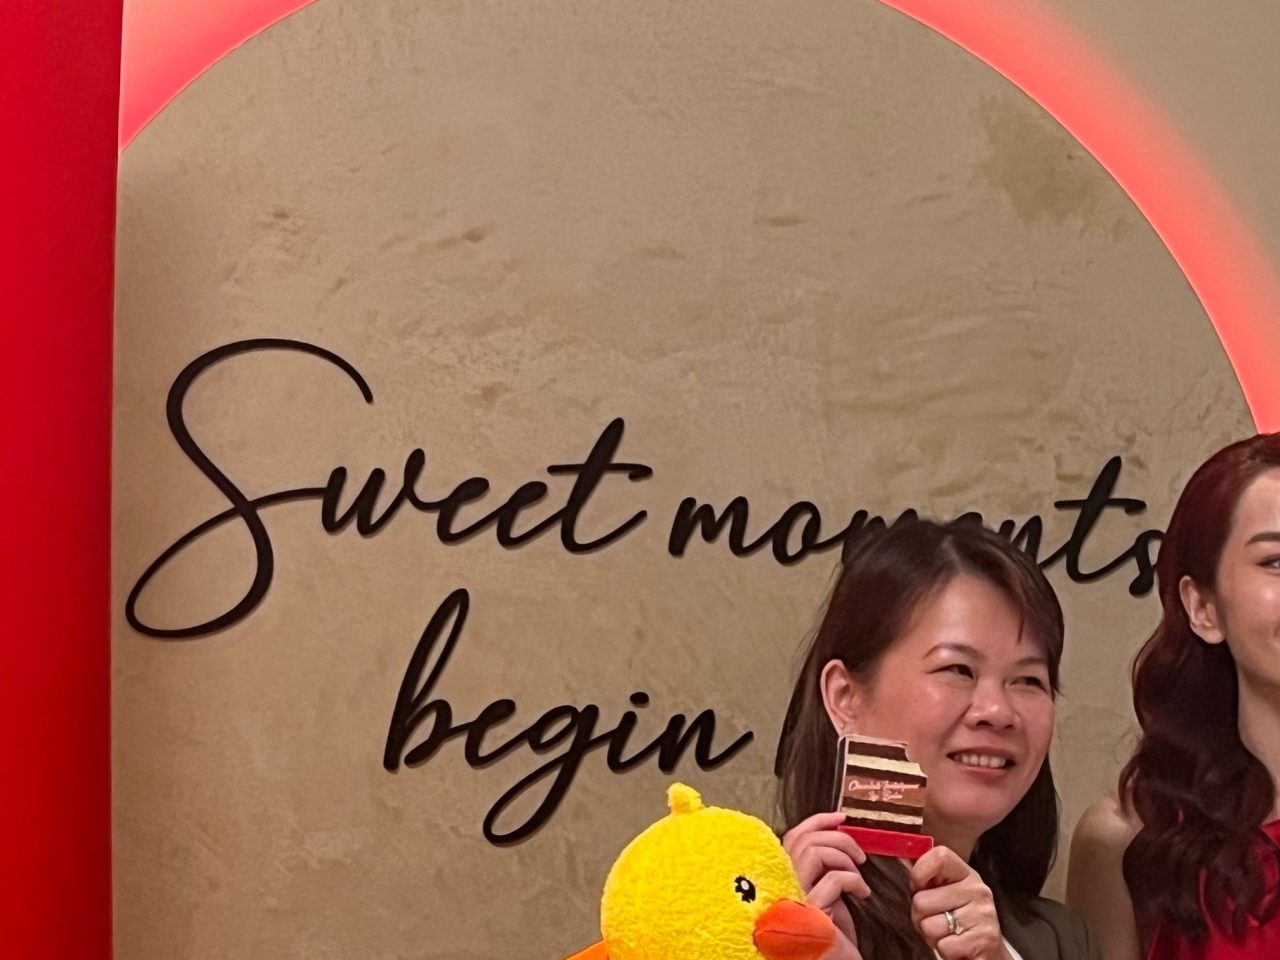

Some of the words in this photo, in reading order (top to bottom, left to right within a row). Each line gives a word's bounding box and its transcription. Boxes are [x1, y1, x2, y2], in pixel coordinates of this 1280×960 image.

[125, 338, 653, 638] Sweet
[668, 456, 1166, 596] monts
[383, 588, 754, 844] begin
